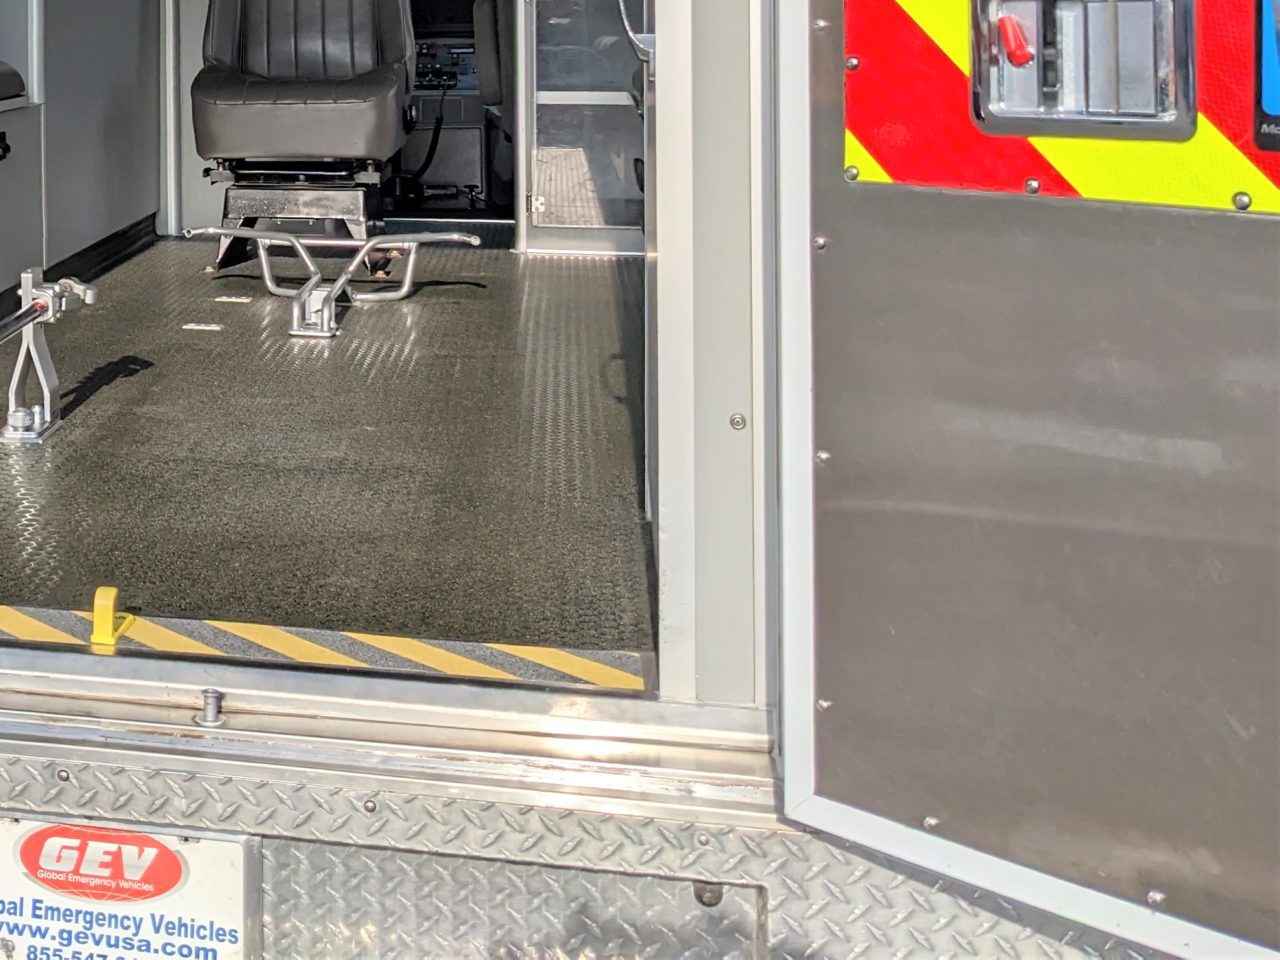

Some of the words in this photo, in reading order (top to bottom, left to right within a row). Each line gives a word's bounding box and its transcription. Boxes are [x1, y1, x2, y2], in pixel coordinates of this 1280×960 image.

[37, 869, 66, 881] Global
[68, 874, 117, 889] Emergency
[119, 879, 155, 892] Vehicles
[38, 836, 159, 881] GEV
[31, 899, 144, 937] Emergency
[150, 912, 239, 945] Vehicles
